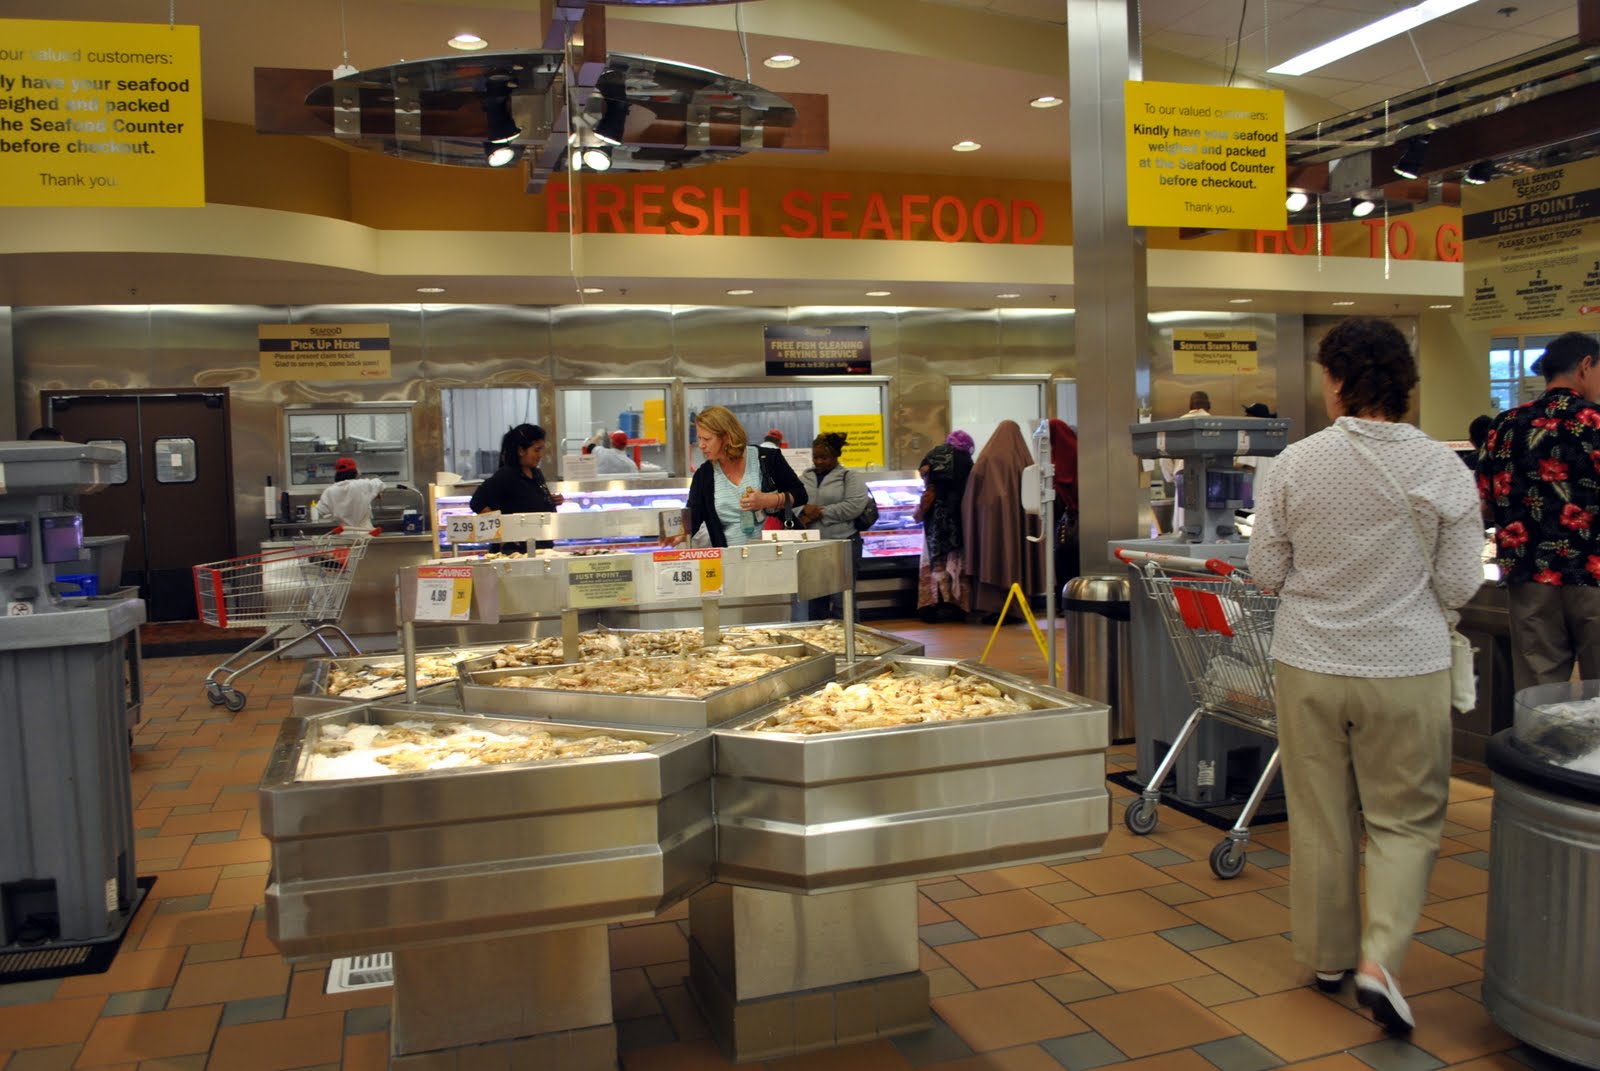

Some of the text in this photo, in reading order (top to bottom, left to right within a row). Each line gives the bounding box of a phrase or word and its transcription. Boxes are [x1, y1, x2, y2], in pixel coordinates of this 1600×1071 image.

[31, 48, 81, 62] valued
[87, 50, 173, 65] customers:
[22, 75, 65, 89] have
[71, 78, 111, 93] your
[117, 78, 190, 92] seafood
[66, 98, 99, 111] and
[105, 98, 170, 114] packed
[1144, 103, 1269, 121] To our valued customers:
[30, 117, 107, 133] Seafood
[113, 118, 184, 134] Counter
[1133, 124, 1279, 142] Kindly have your seafood
[0, 138, 155, 154] before checkout.
[1148, 141, 1267, 158] weighed and packed
[1139, 158, 1275, 174] at the Seafood Counter
[40, 173, 85, 186] Thank
[1159, 174, 1257, 189] before checkout.
[1513, 169, 1565, 189] FULL SERVICE
[544, 180, 1046, 247] FRESH SEAFOOD
[1184, 201, 1235, 215] Thank you.
[1492, 195, 1590, 225] JUST POINT...
[1362, 218, 1416, 260] TO
[1497, 238, 1525, 249] PLEASE
[1526, 236, 1538, 245] DO
[1539, 232, 1554, 244] NOT
[1556, 229, 1582, 240] TOUCH
[1536, 270, 1542, 279] 2
[290, 339, 360, 350] PICK UP HERE
[771, 341, 864, 350] FREE FISH CLEANING
[784, 350, 817, 358] FRYING
[819, 350, 858, 358] SERVICE
[453, 522, 474, 533] 2.99
[480, 518, 501, 532] 2.79
[679, 550, 720, 560] SAVINGS
[438, 568, 471, 578] SAVINGS
[575, 573, 594, 581] JUST
[672, 570, 693, 583] 4.99
[430, 589, 447, 602] 4.99
